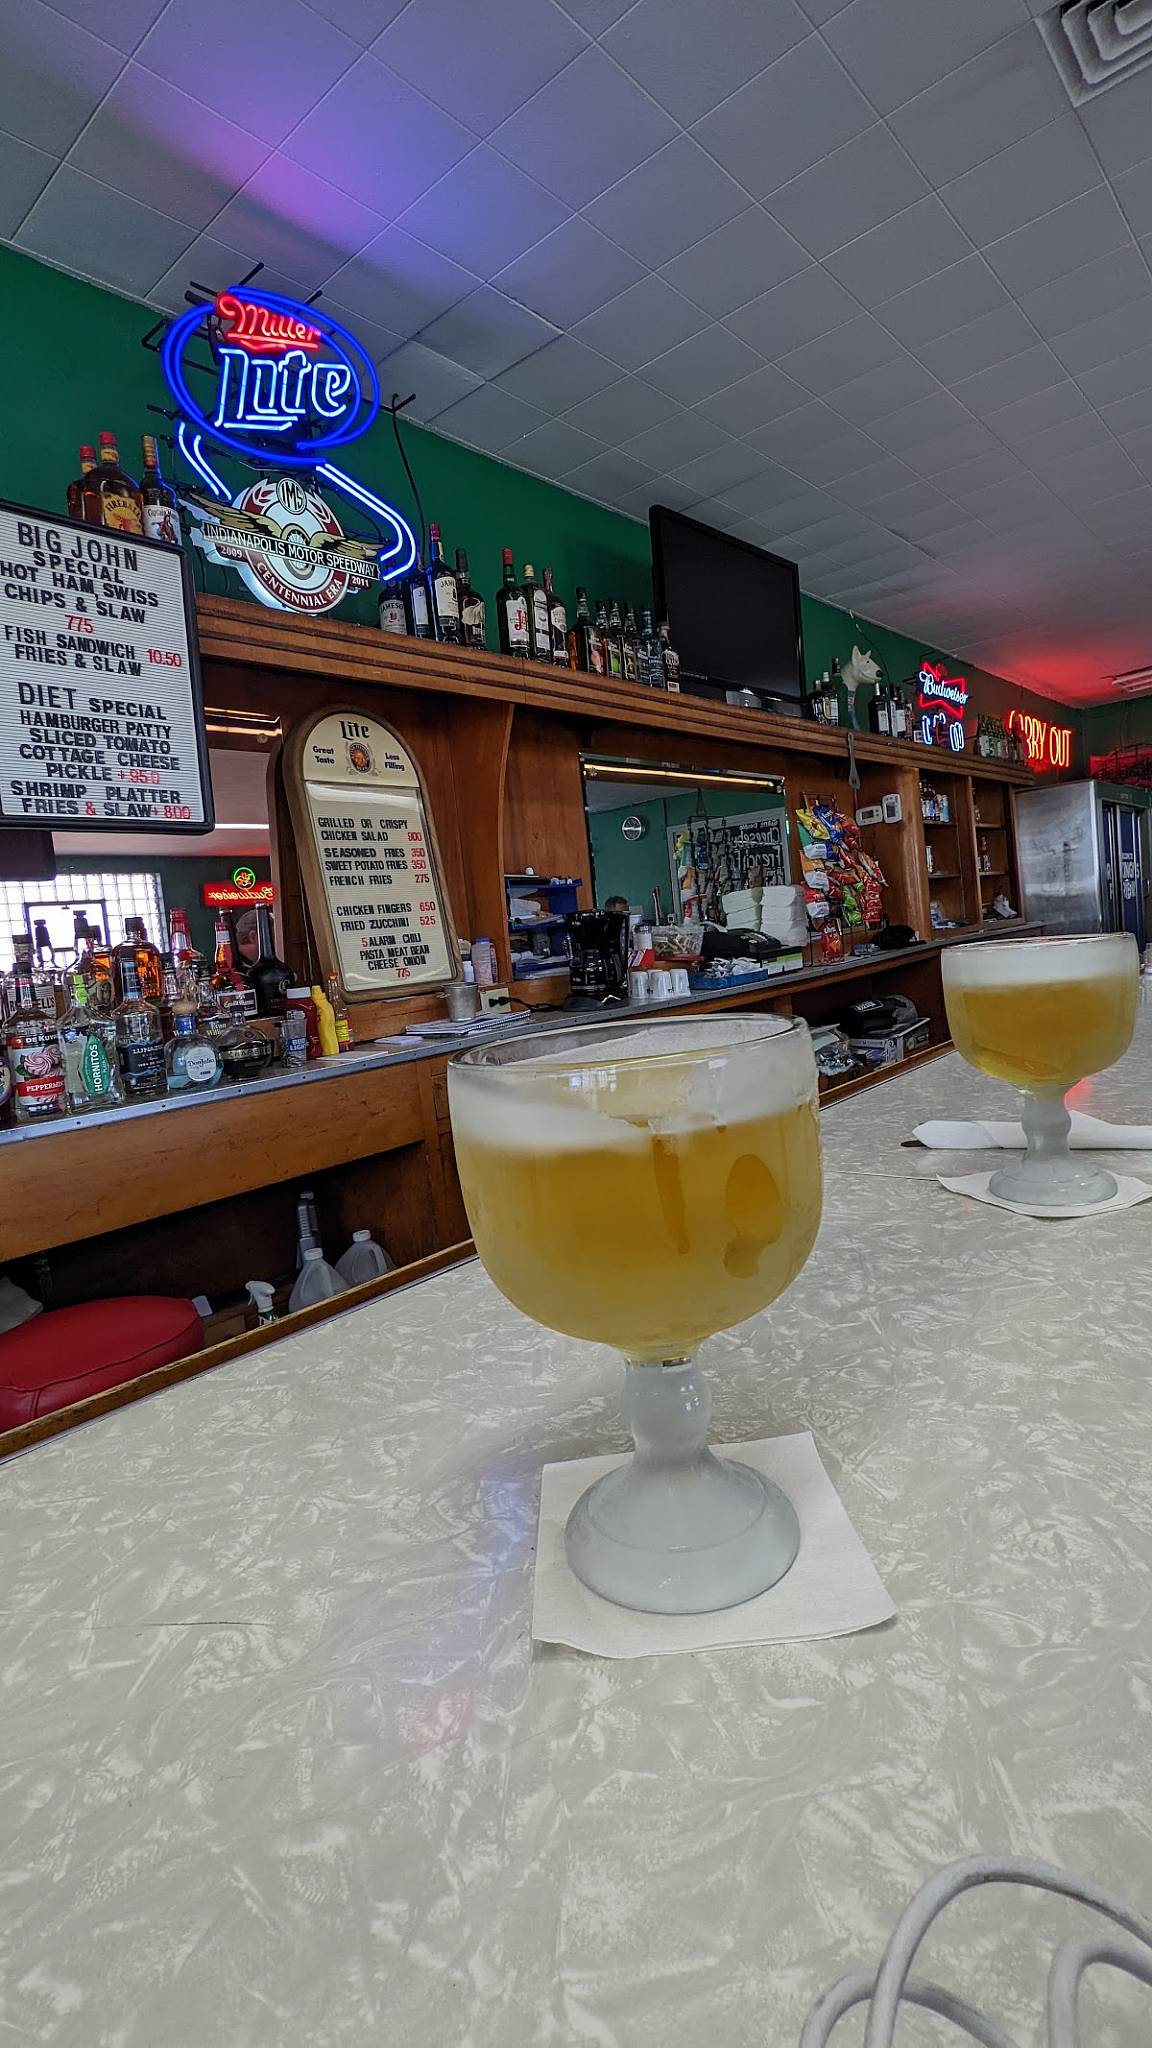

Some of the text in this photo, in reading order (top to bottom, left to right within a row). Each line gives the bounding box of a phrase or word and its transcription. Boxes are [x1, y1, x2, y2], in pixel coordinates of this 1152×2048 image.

[218, 295, 322, 341] Miller
[214, 348, 351, 431] Lite
[282, 483, 302, 511] IMS
[17, 522, 139, 572] BIG JOHN
[206, 523, 376, 577] INDIANAPOLIS MOTOR SPEEDWAY
[220, 545, 243, 559] 2009
[33, 551, 124, 585] SPECIAL
[1, 560, 159, 608] HOT HAM, SWISS
[256, 562, 343, 607] CENTENNIAL ERA
[351, 576, 370, 587] 2011
[4, 583, 146, 624] CHIPS & SLAW
[381, 602, 404, 612] JAMESO
[65, 615, 94, 634] 775
[4, 625, 47, 646] FISH
[56, 633, 135, 660] SANDWICH
[14, 643, 142, 677] FRIES & SLAW
[919, 671, 968, 704] Budweiser
[17, 682, 167, 720] DIET SPECIAL
[19, 710, 172, 740] HAMBURGER PATTY
[339, 720, 370, 741] Lite
[29, 728, 171, 755] SLICED TOMATO
[312, 745, 334, 755] Great
[1050, 726, 1072, 767] OUT
[19, 743, 181, 771] COTTAGE CHEESE
[315, 756, 335, 764] Taste
[384, 762, 405, 771] Filling
[385, 752, 400, 761] Less
[45, 762, 113, 782] PICKLE
[10, 780, 181, 804] SHRIMP PLATTER
[21, 798, 80, 815] FRIES
[85, 801, 97, 816] &
[104, 802, 151, 817] SLAW
[318, 817, 408, 830] GRILLED OR CRISPY
[321, 830, 358, 841] CHICKEN
[361, 831, 389, 842] SALAD
[324, 848, 426, 858] SEASONED FRIES 350
[325, 860, 353, 871] SWEET
[355, 860, 385, 871] POTATO
[386, 860, 408, 870] FRIES
[329, 874, 430, 886] FRENCH FRIES 275
[336, 901, 436, 917] CHICKEN FINGERS 650
[341, 916, 436, 932] FRIED ZUCCHINI 525
[402, 933, 421, 944] CHILI
[360, 944, 430, 960] PASTA MEAT BEAN
[367, 955, 426, 971] CHEESE ONION
[90, 1044, 103, 1092] HORNITOS
[26, 1080, 64, 1093] PEPPERMIN
